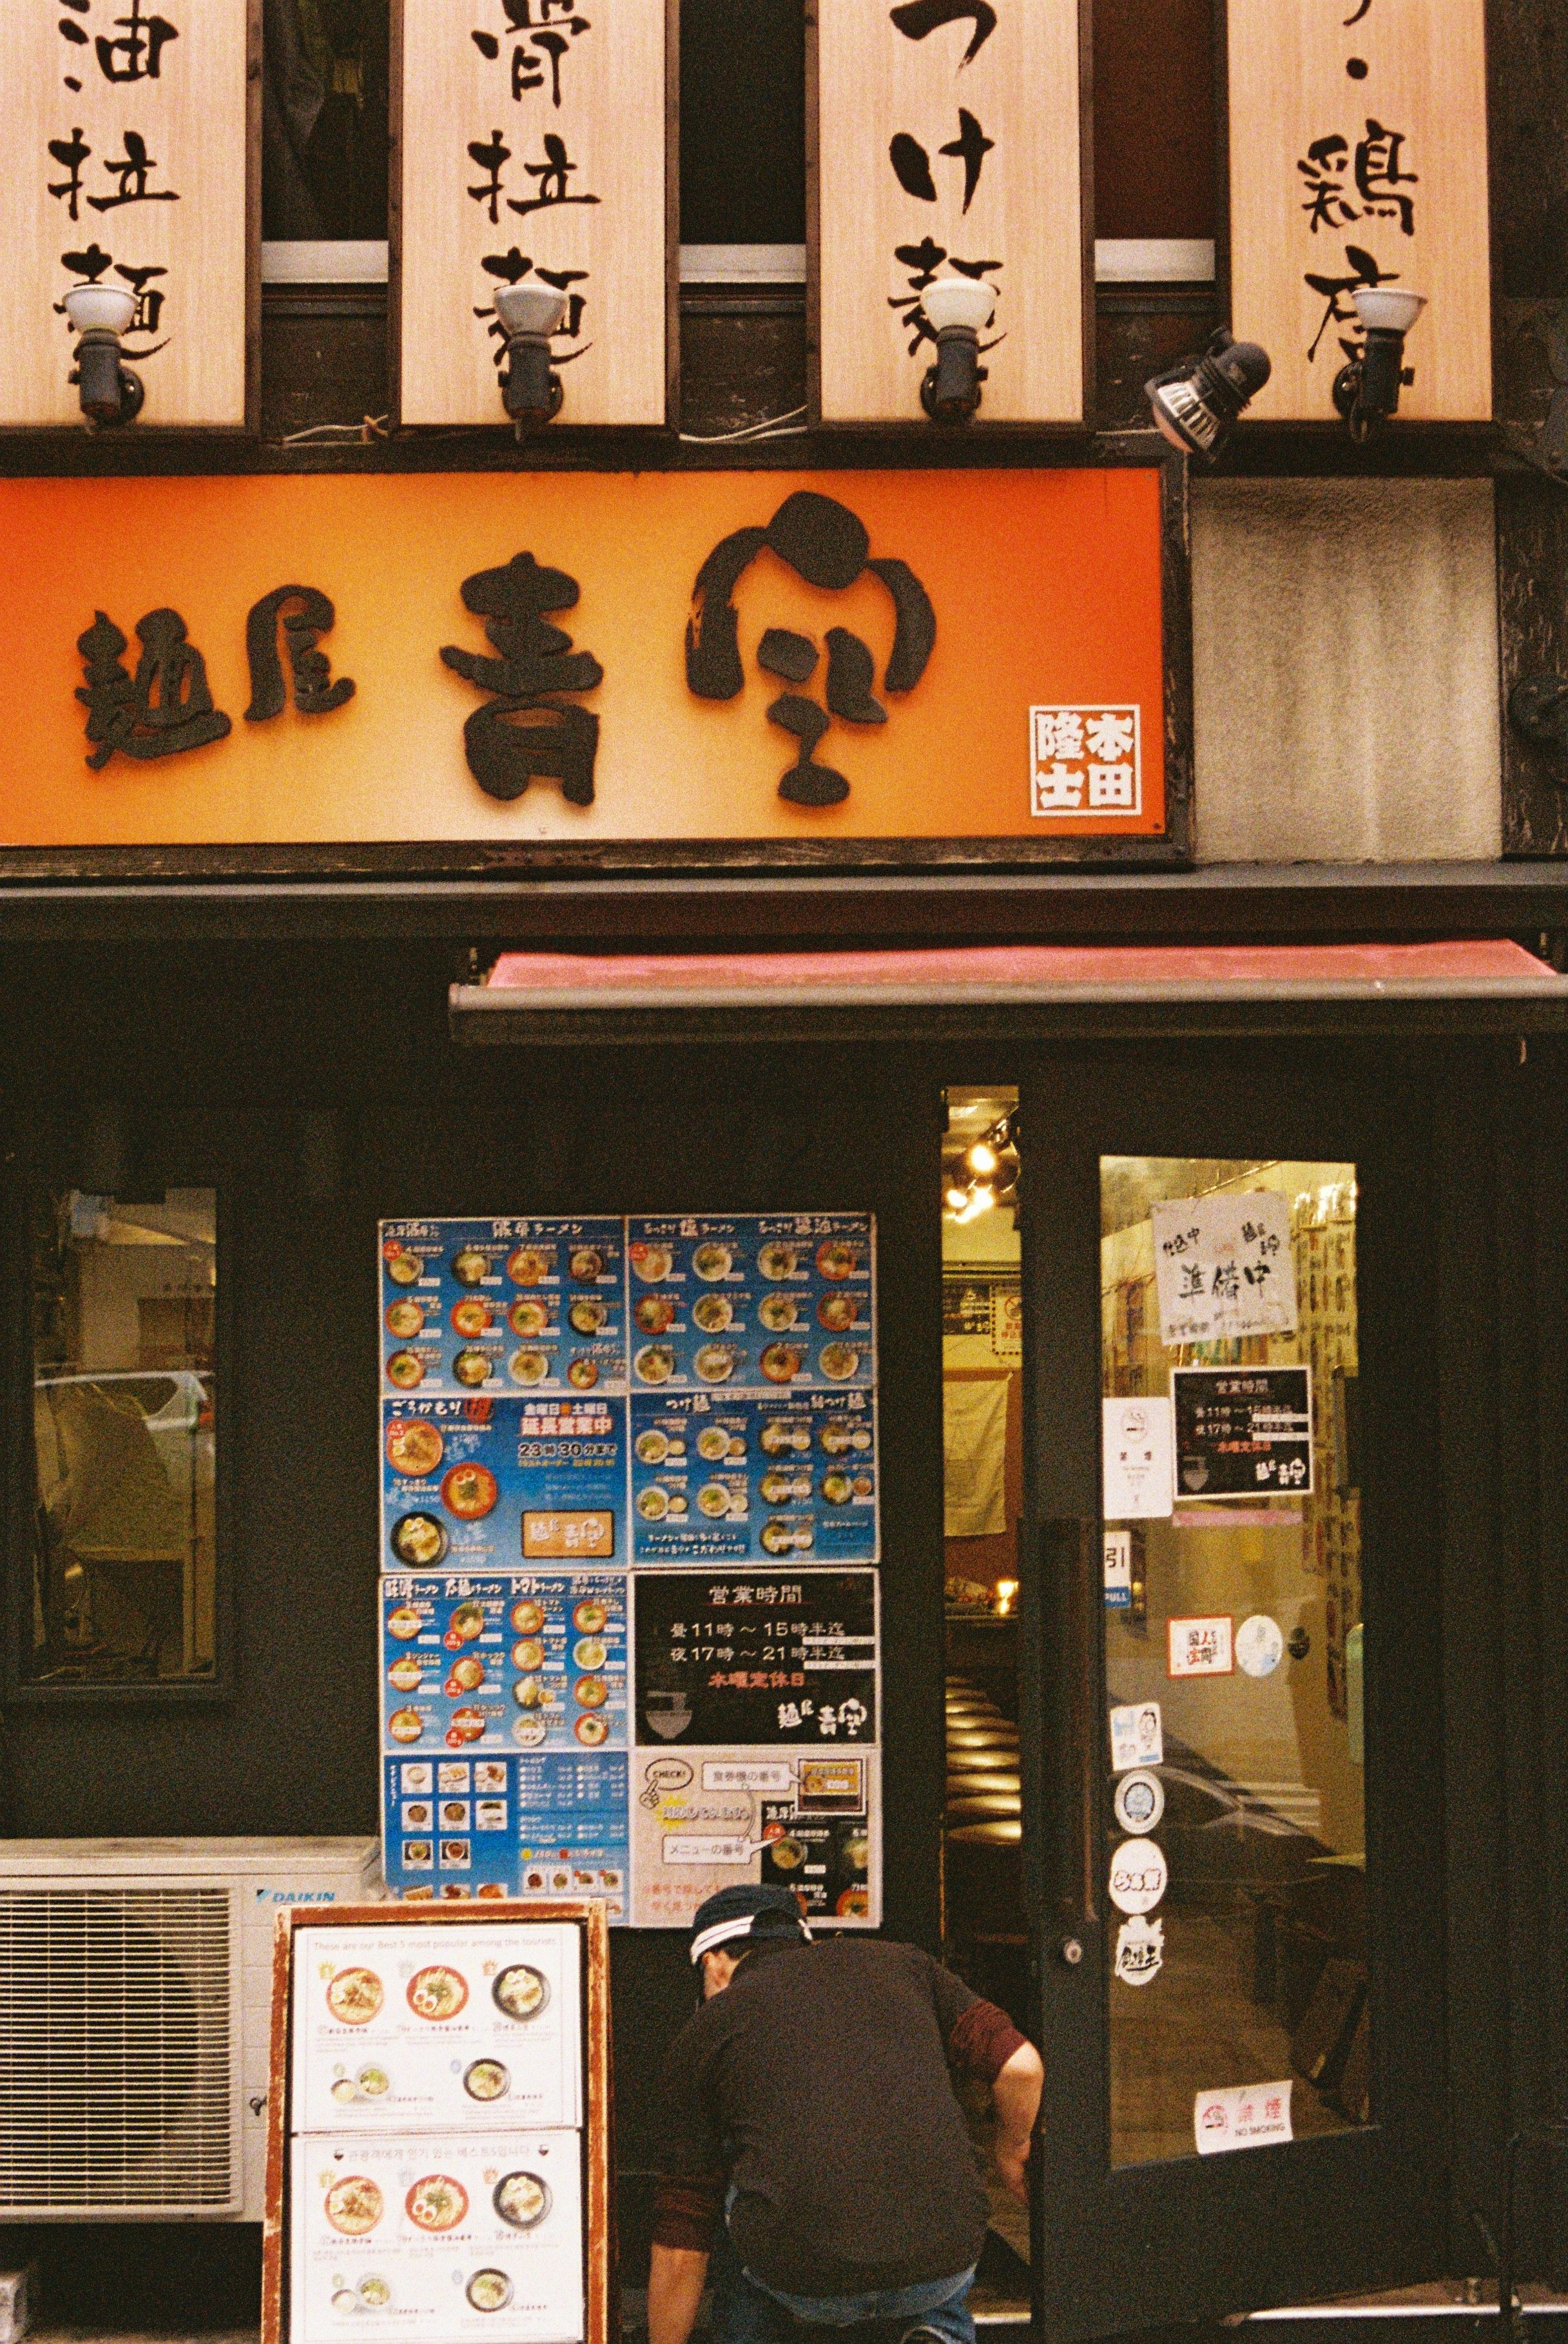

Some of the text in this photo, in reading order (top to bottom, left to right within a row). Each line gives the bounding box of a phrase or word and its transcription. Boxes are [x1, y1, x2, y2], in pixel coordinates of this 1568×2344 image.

[1178, 1259, 1272, 1303] 準備中
[1106, 1547, 1125, 1568] 引
[710, 1585, 801, 1604] 営業時間
[670, 1845, 744, 1855] メニューの番号
[273, 1892, 335, 1901] DAIKIN
